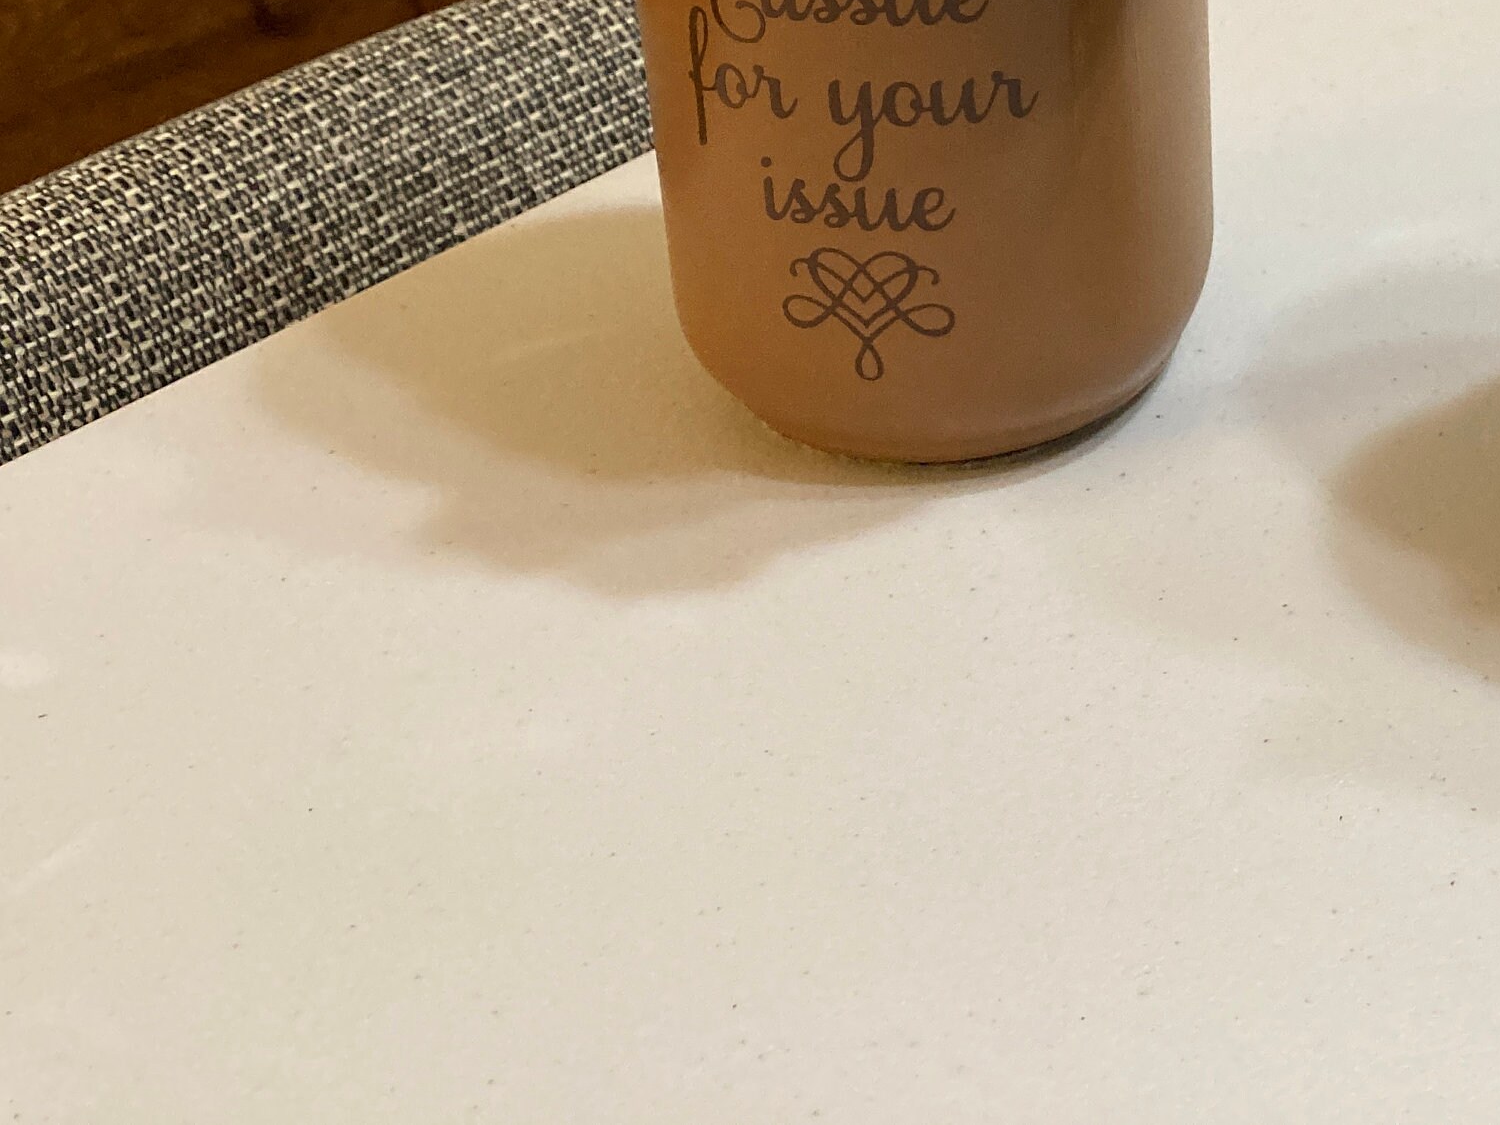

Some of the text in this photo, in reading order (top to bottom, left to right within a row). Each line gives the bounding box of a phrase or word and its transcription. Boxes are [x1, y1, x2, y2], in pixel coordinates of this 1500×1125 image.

[688, 6, 1041, 183] for your
[760, 157, 956, 232] issue
